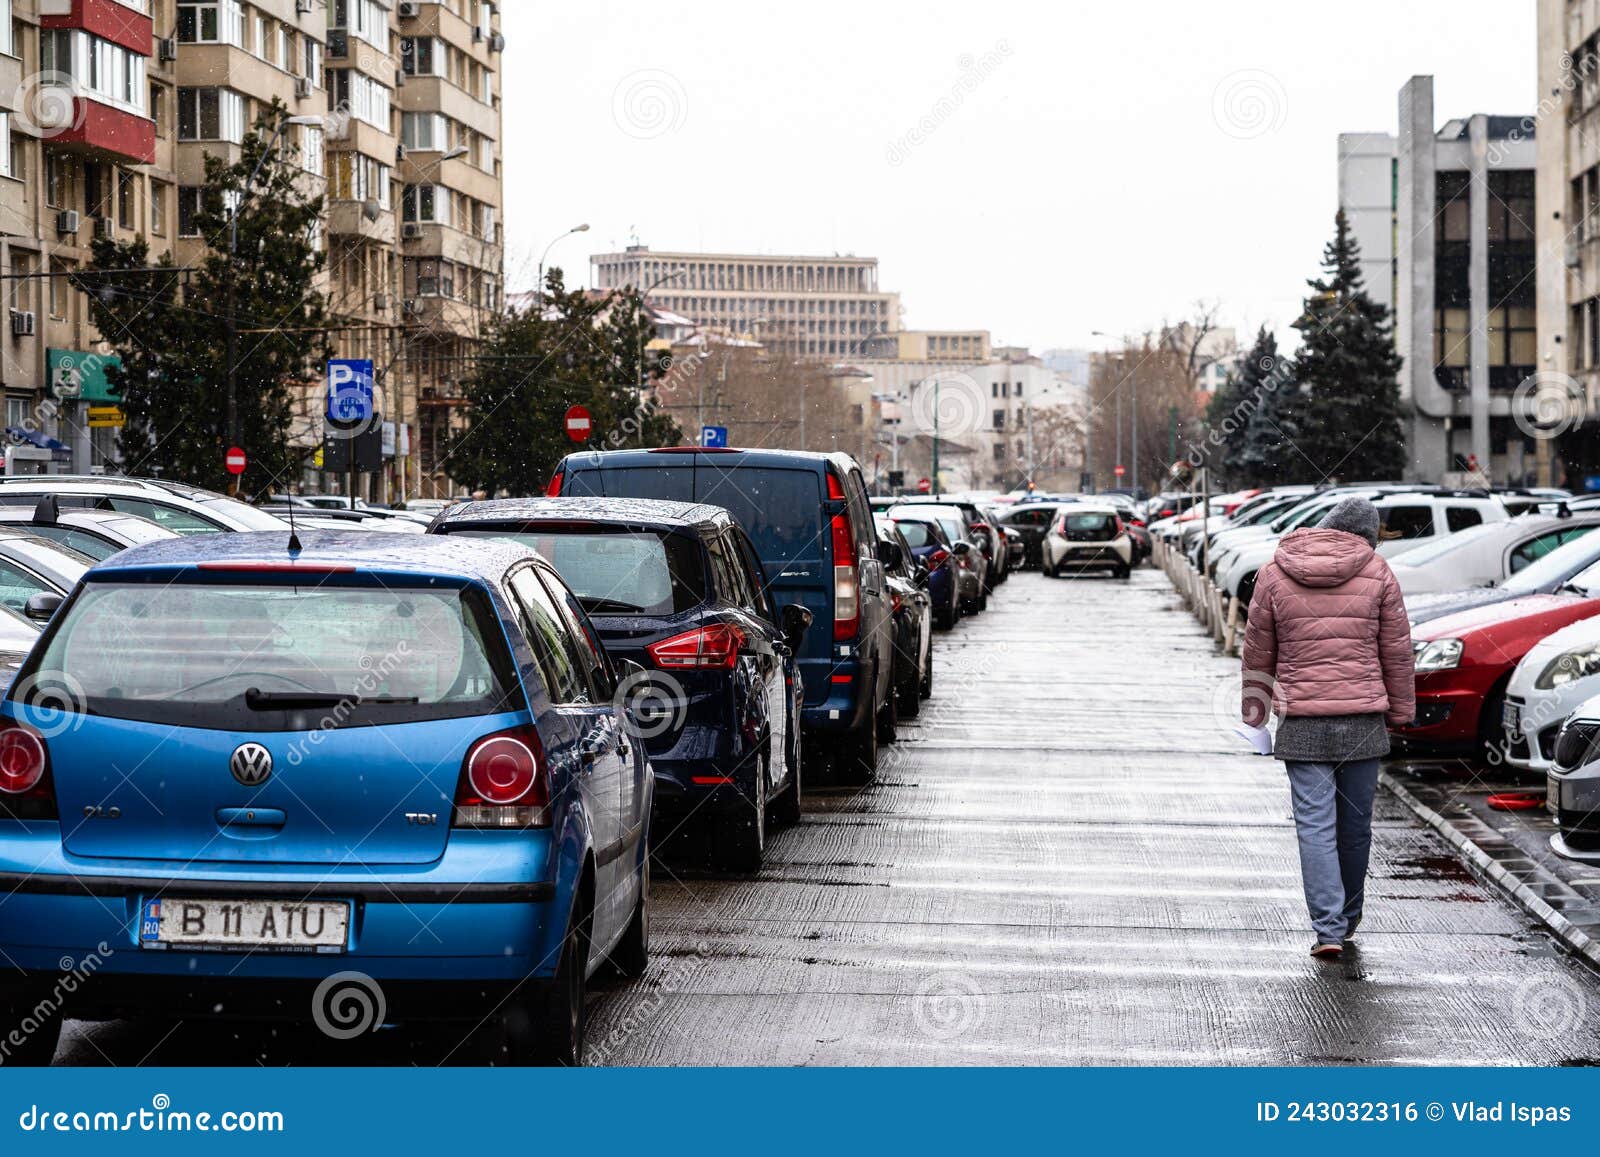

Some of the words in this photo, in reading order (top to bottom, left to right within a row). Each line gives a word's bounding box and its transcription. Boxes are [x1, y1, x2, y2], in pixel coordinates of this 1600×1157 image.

[329, 364, 353, 397] P
[703, 428, 717, 447] P
[405, 812, 437, 826] TDI
[143, 921, 159, 936] RO
[181, 903, 206, 936] B
[219, 904, 242, 937] 11
[259, 905, 326, 940] ATU
